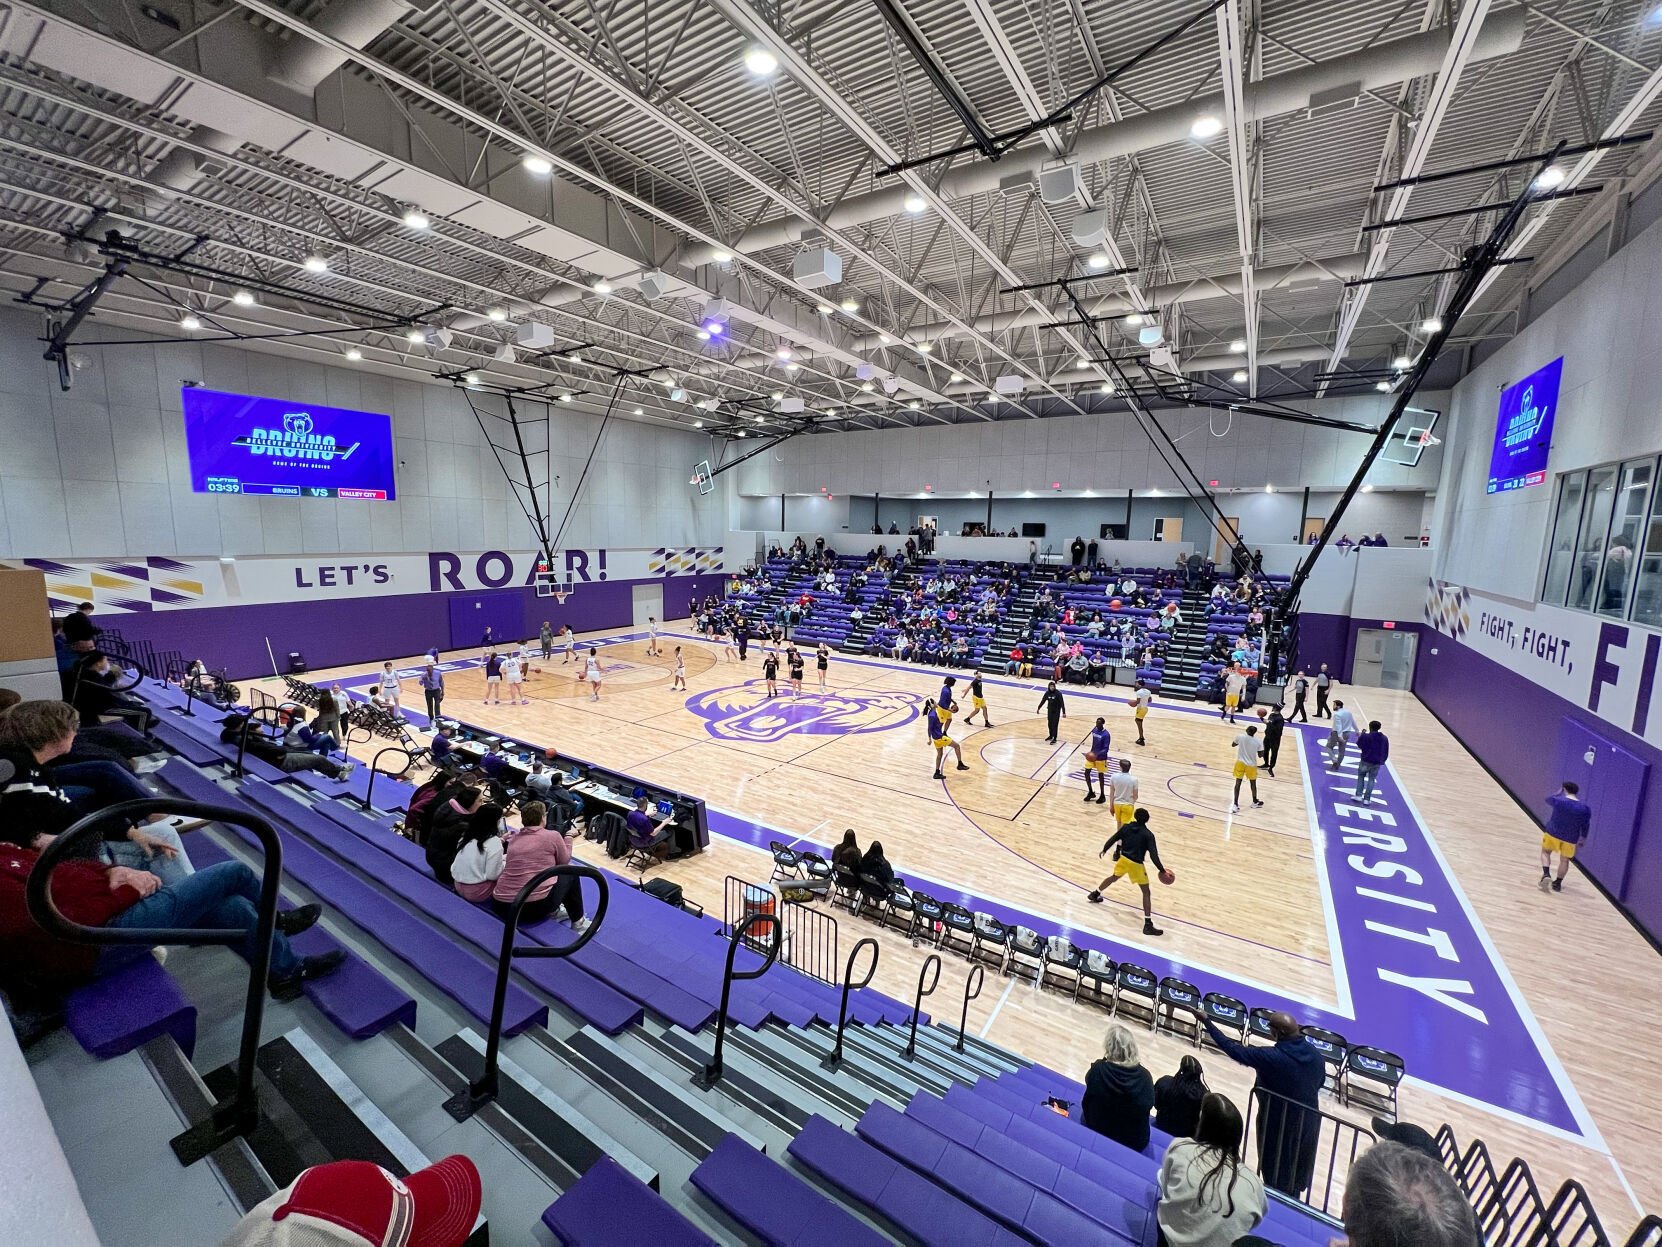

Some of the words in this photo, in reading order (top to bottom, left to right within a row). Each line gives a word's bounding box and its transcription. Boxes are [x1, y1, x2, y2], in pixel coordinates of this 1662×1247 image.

[208, 483, 239, 492] 03:39
[311, 488, 328, 496] VS
[295, 564, 389, 588] LET'S
[1480, 612, 1515, 649] FIGHT,
[1522, 626, 1573, 675] FIGHT,
